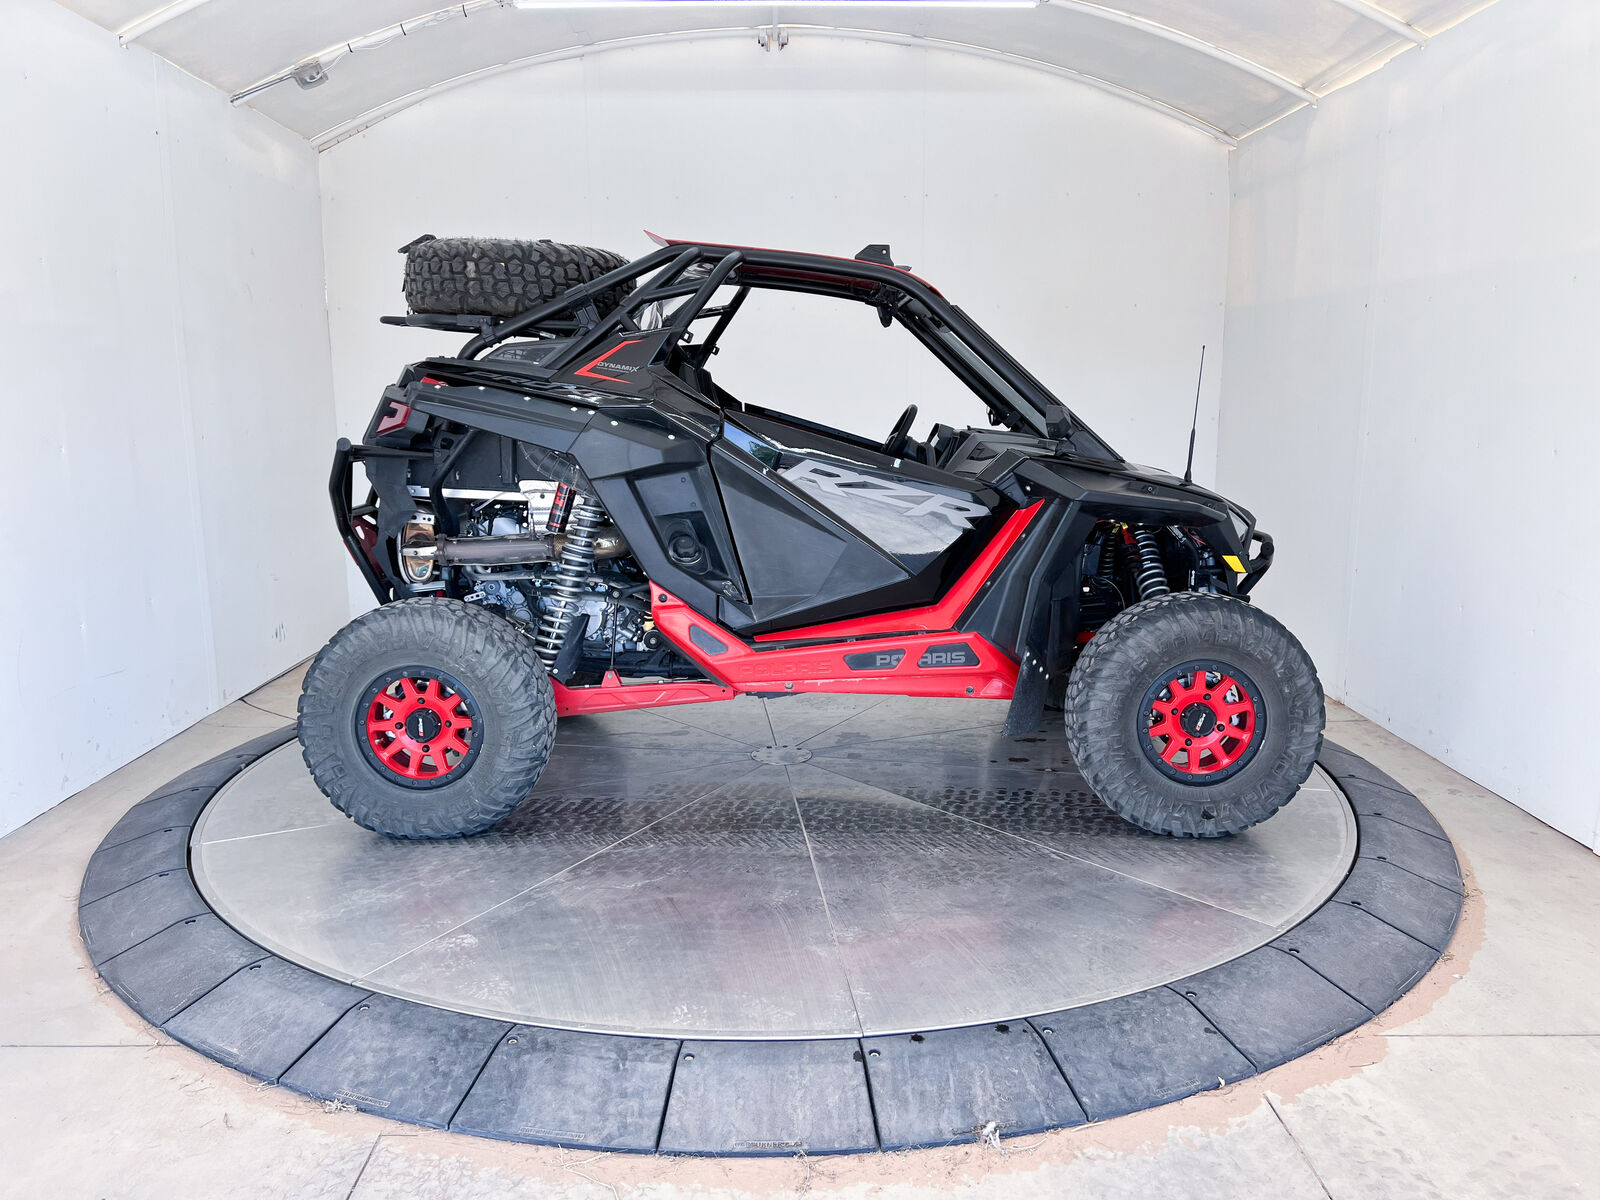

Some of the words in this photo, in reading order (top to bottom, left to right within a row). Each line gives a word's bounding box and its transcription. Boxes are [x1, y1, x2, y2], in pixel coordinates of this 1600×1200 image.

[597, 361, 640, 373] DYNAMIX
[781, 458, 993, 530] RZR
[875, 651, 966, 667] POARIS
